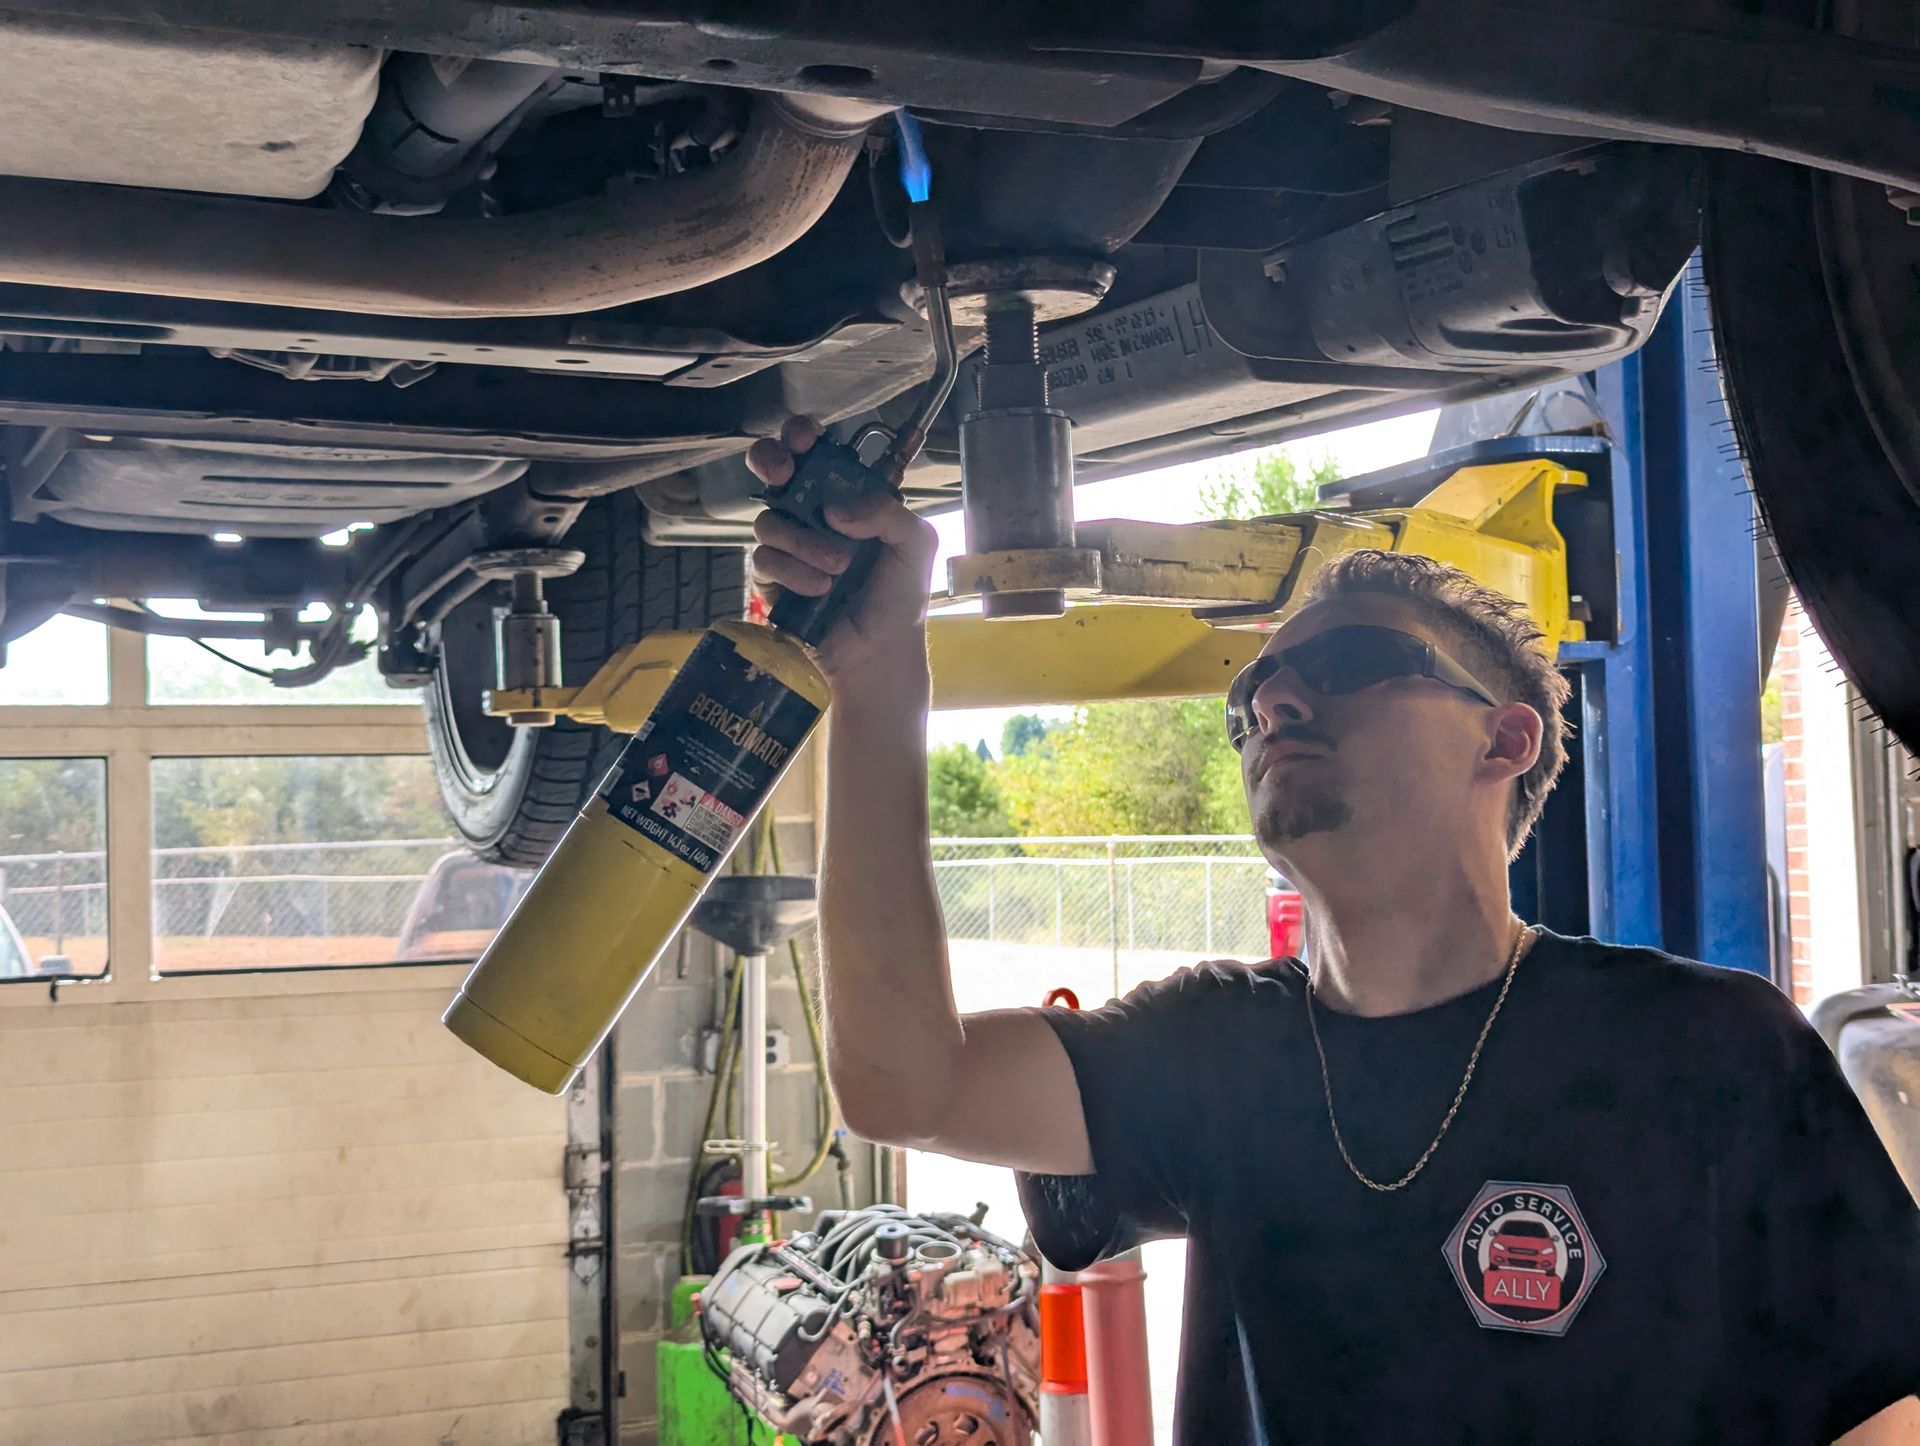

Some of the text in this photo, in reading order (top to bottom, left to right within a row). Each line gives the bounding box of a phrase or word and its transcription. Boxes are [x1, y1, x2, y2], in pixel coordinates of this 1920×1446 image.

[1119, 338, 1134, 357] IN
[1133, 325, 1174, 352] CANADA
[1172, 298, 1213, 358] LH
[688, 692, 789, 768] BERNZOMATIC
[620, 804, 638, 820] NET
[635, 813, 669, 841] WEIGHT
[1466, 1196, 1582, 1259] AUTO SERVICE
[1493, 1277, 1552, 1301] ALLY
